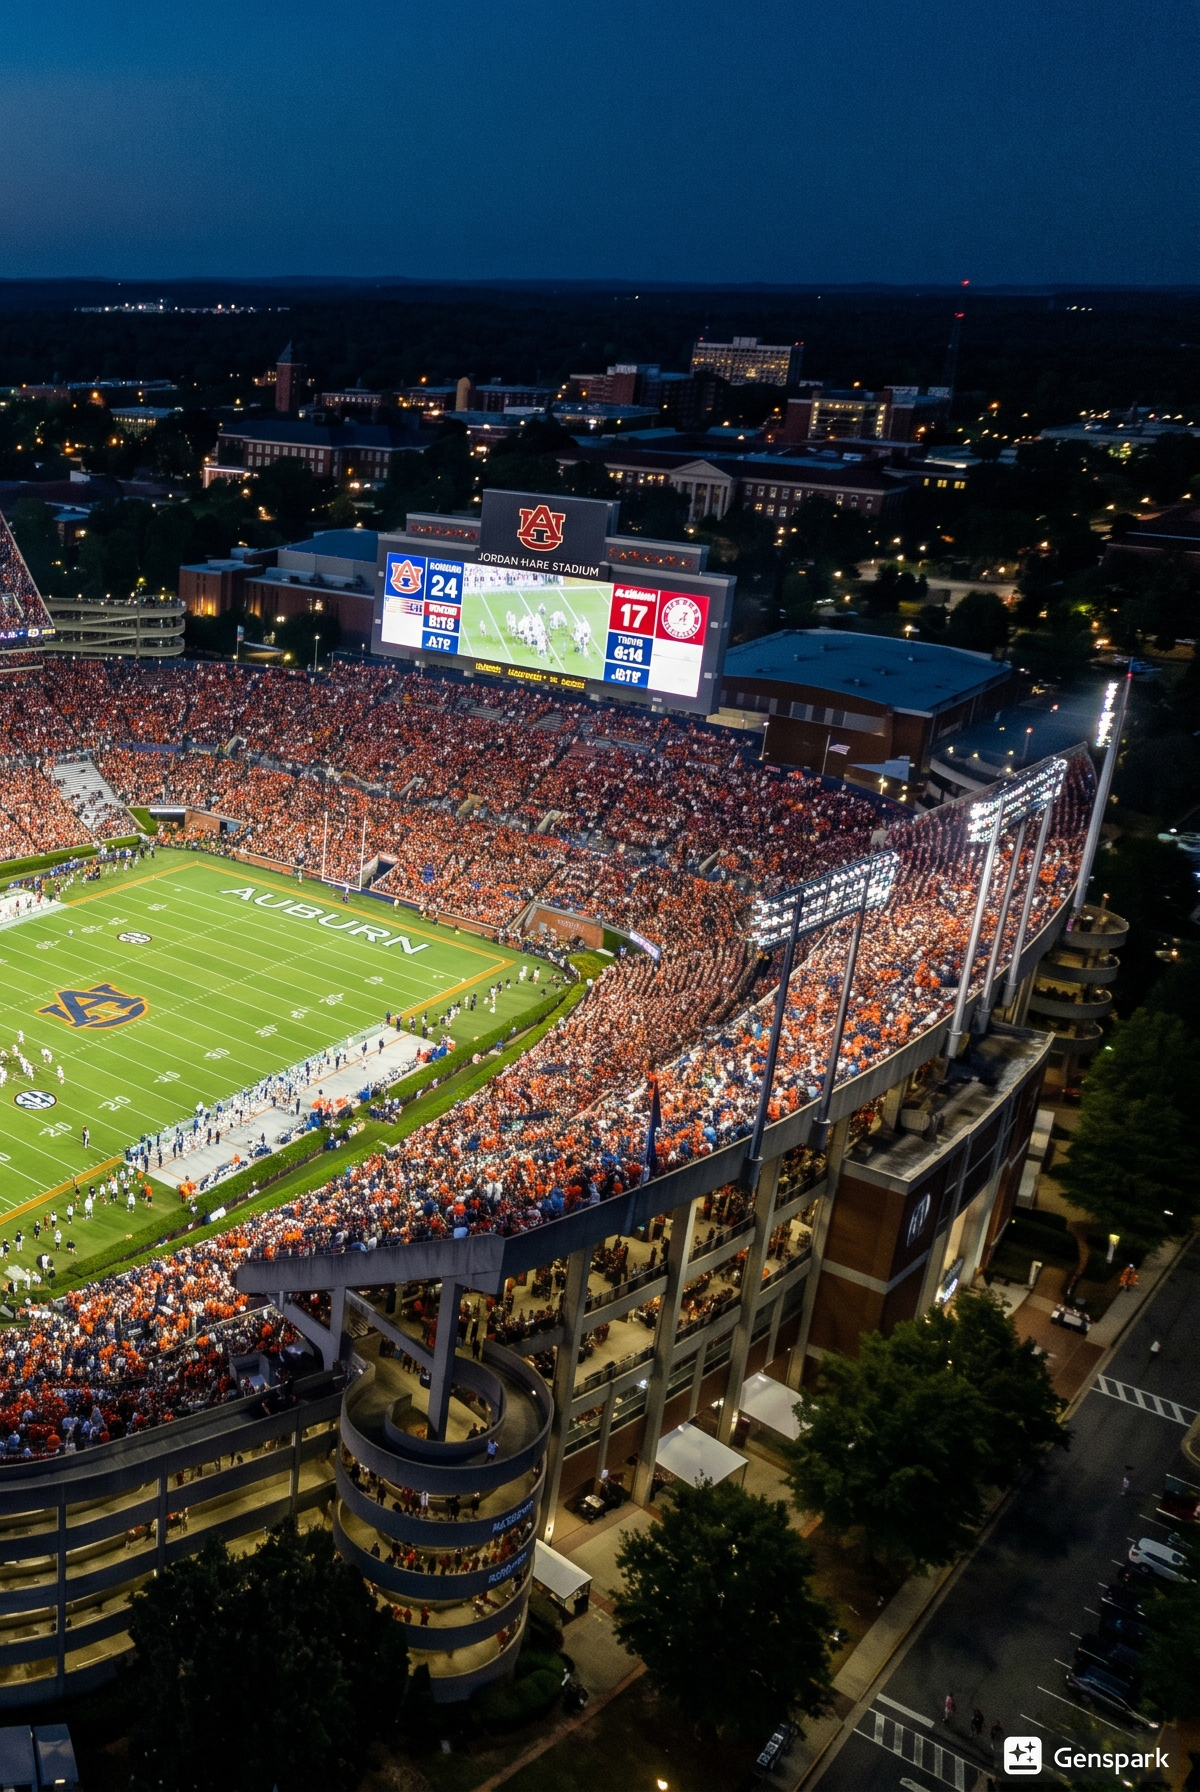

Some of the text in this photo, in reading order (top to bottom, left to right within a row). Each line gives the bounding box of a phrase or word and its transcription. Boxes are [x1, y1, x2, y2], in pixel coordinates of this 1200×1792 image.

[477, 552, 518, 566] JORDAN
[552, 562, 599, 577] STADIUM
[430, 575, 458, 598] 24
[620, 603, 648, 628] 17
[218, 887, 431, 955] AUBURN
